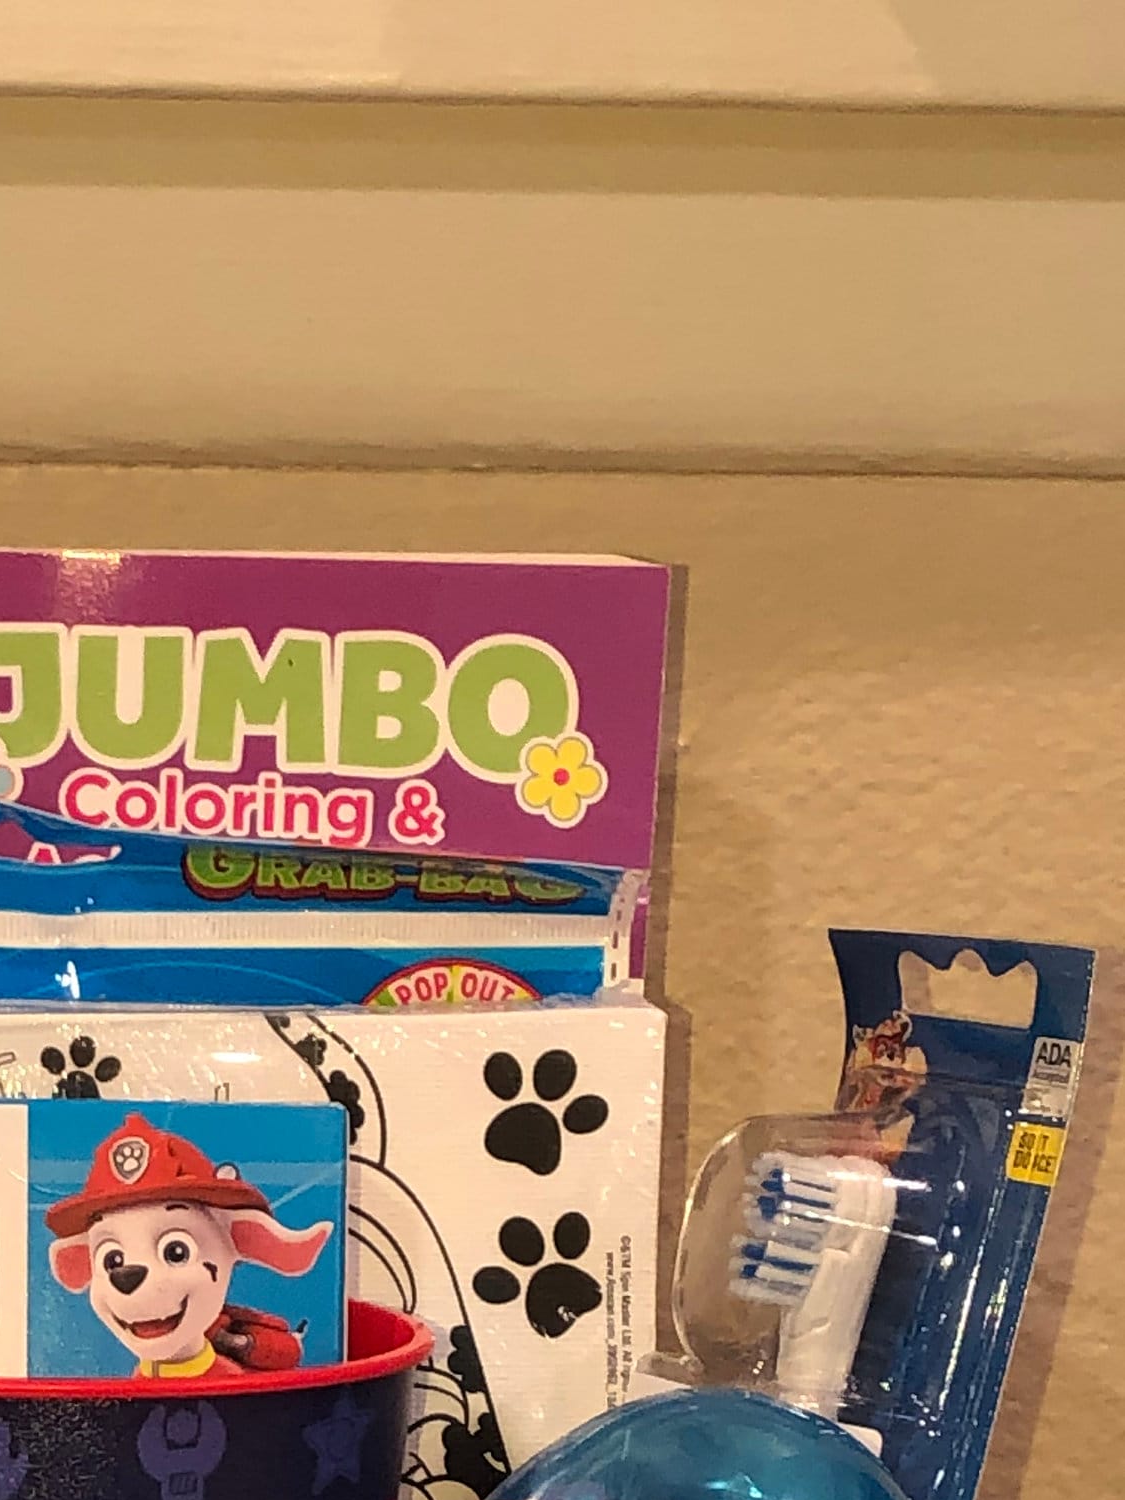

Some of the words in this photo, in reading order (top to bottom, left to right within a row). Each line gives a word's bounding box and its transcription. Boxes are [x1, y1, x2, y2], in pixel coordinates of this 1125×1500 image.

[62, 770, 371, 848] Coloring
[390, 781, 445, 844] &
[395, 972, 449, 1005] POP
[1035, 1041, 1072, 1069] ADA
